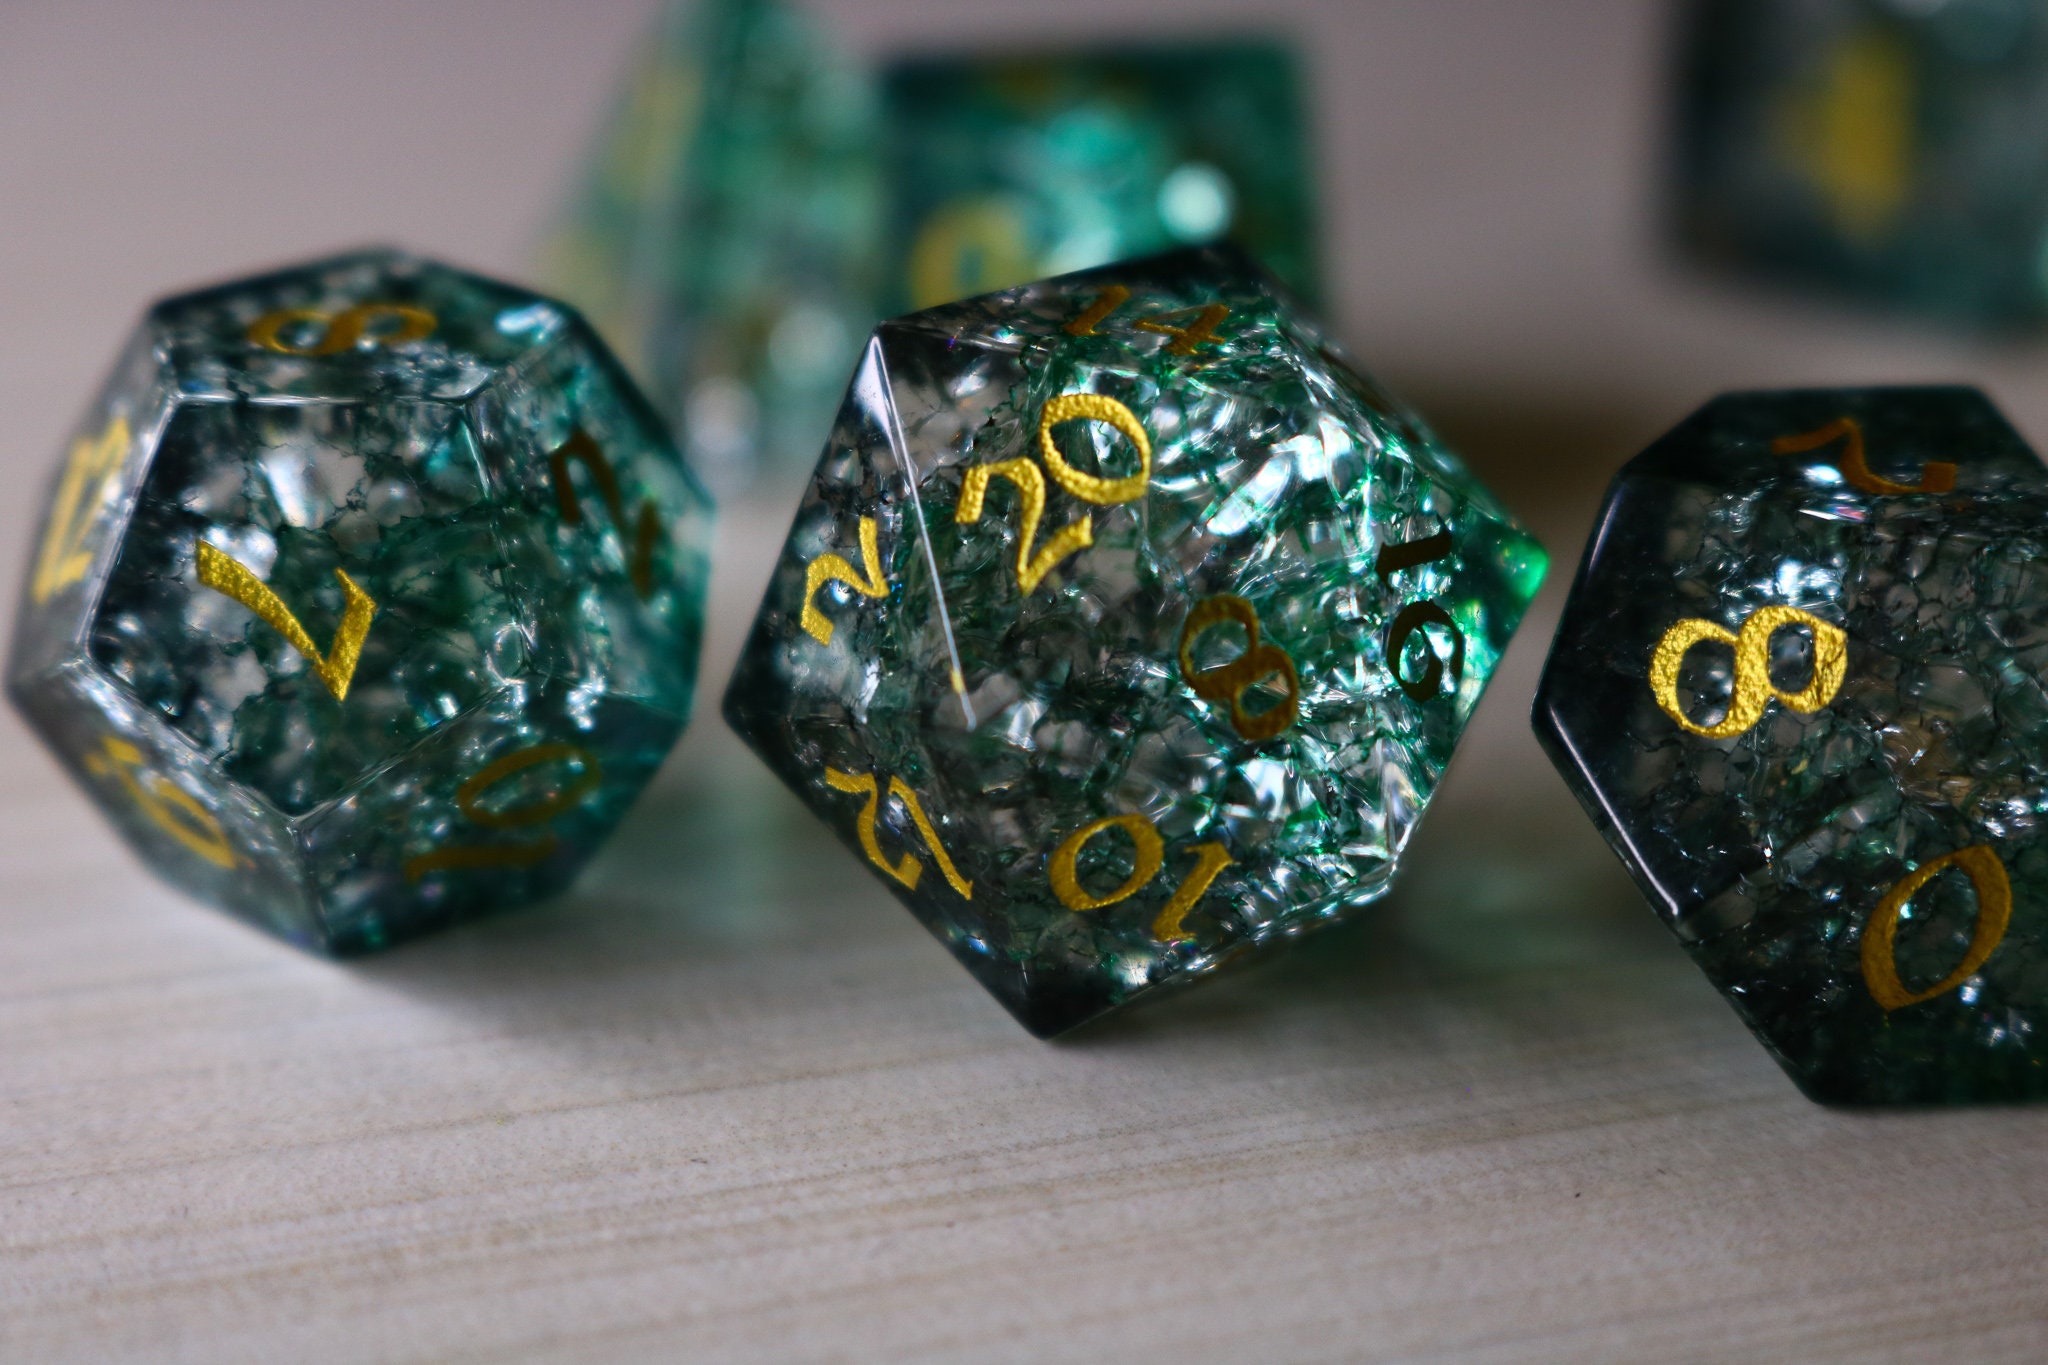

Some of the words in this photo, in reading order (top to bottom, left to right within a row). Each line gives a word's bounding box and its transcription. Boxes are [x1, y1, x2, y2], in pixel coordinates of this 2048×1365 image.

[249, 305, 437, 356] 8
[1062, 285, 1231, 355] 14
[955, 393, 1151, 595] 20
[195, 537, 377, 702] 7
[801, 517, 891, 647] 2
[1180, 594, 1299, 741] 8
[1649, 605, 1848, 739] 8
[403, 742, 599, 883] 10
[1049, 813, 1237, 944] 10
[1860, 845, 2012, 1011] 0
